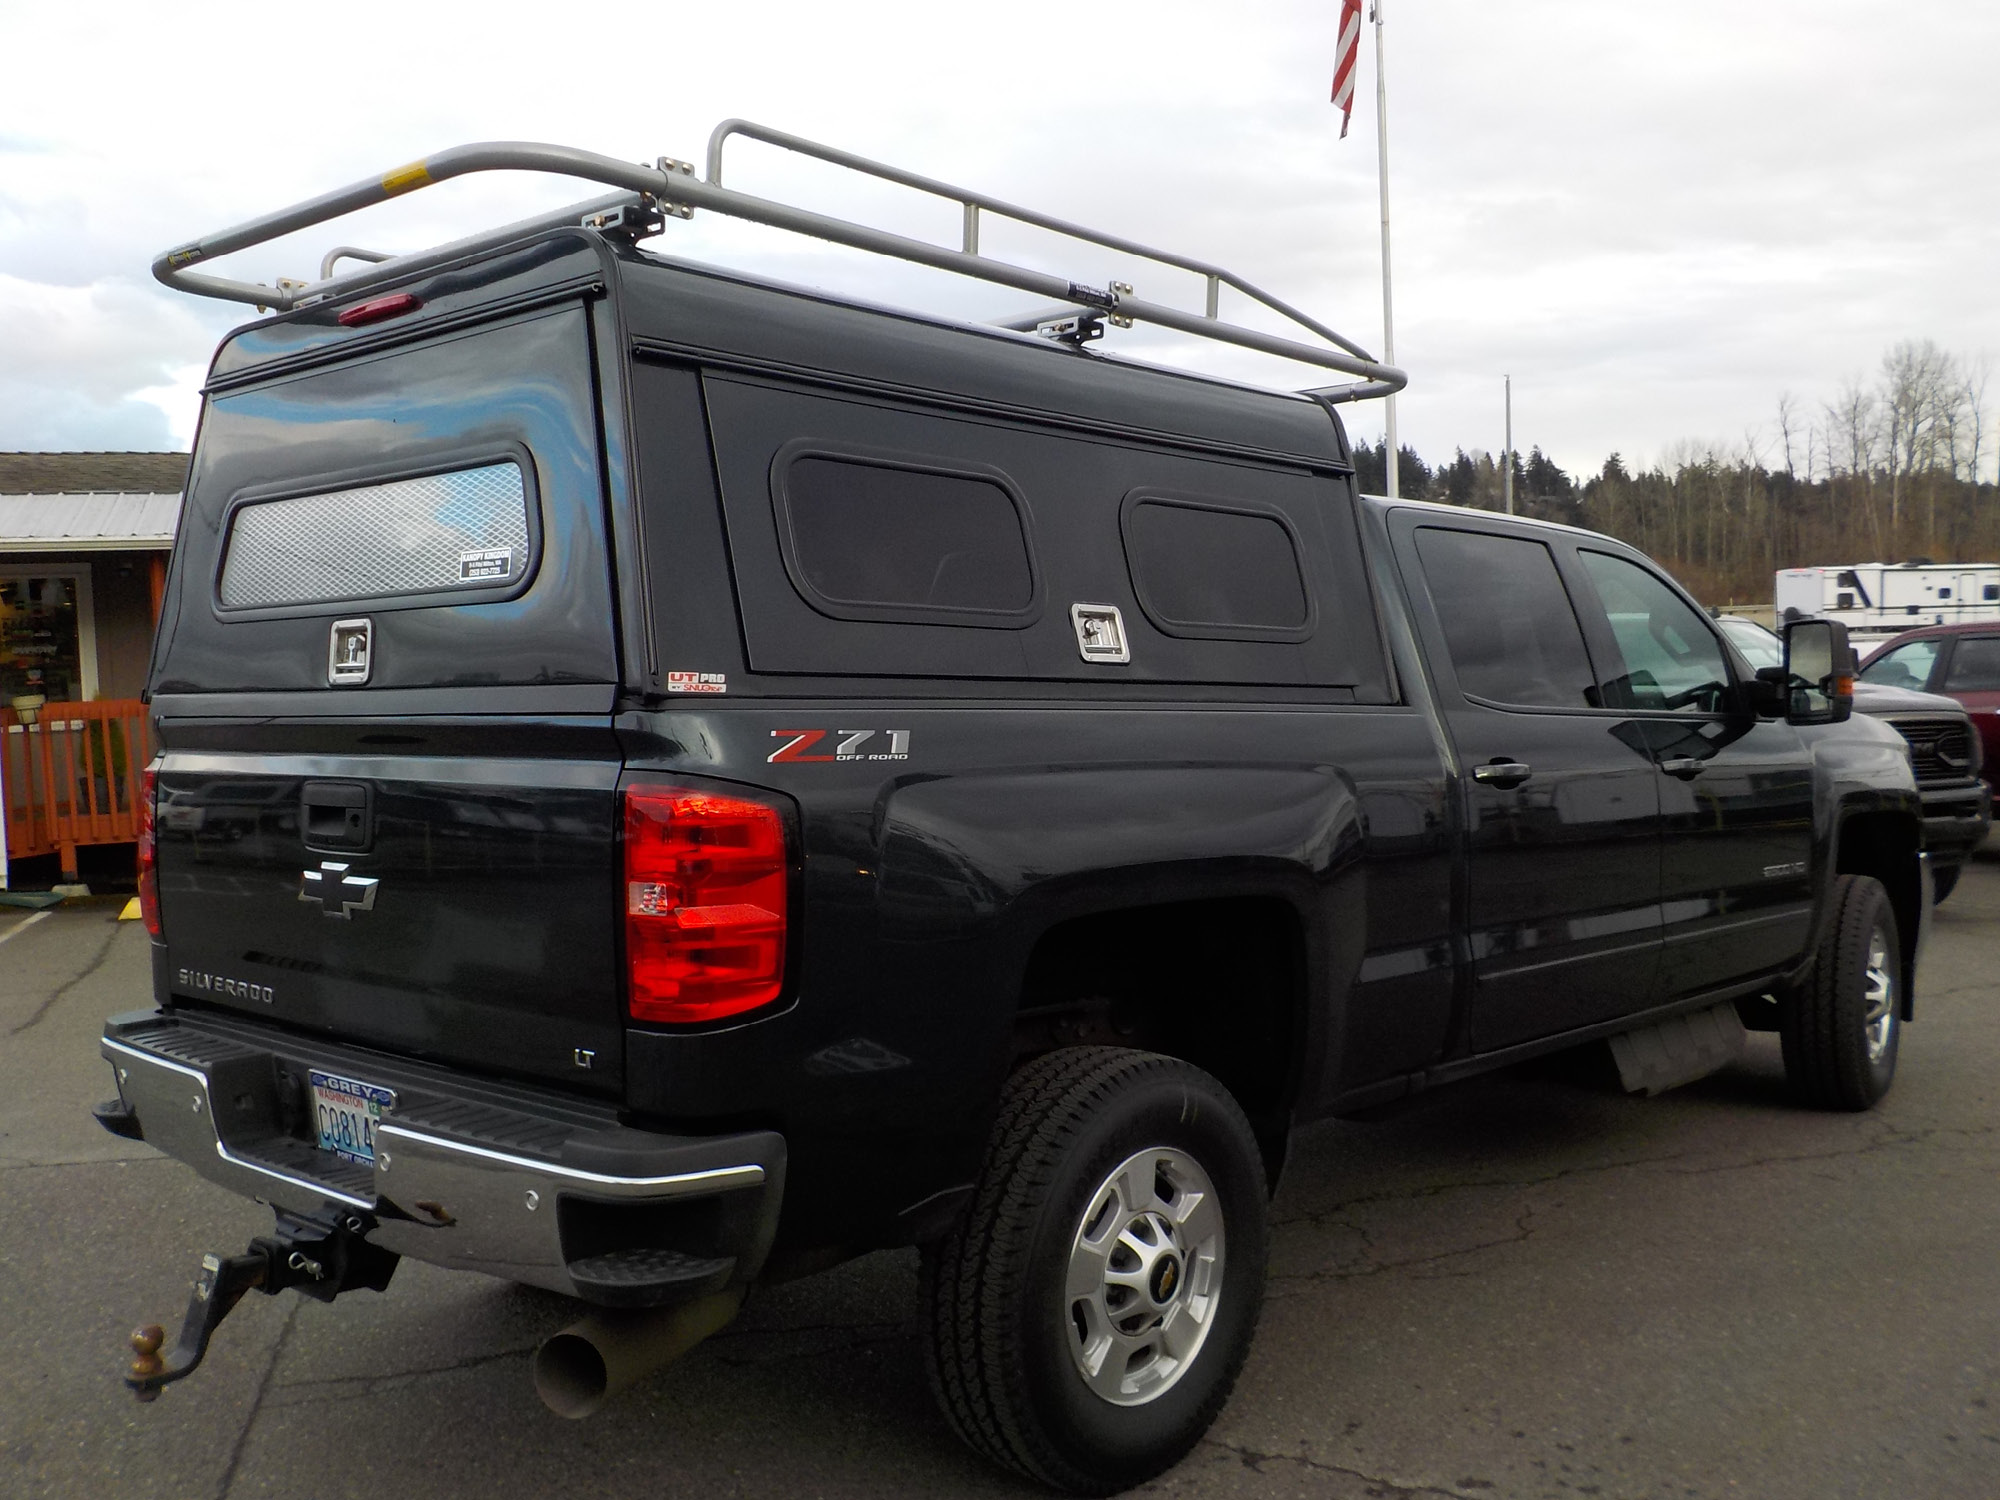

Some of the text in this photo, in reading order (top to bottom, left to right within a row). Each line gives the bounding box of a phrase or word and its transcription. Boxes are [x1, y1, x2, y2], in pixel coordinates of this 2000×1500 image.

[462, 551, 509, 561] KANOPY KINGDOM
[670, 673, 726, 683] UT PRO
[767, 730, 911, 763] Z71
[178, 968, 274, 1004] SILVERADO
[574, 1048, 596, 1069] LT
[327, 1077, 374, 1098] GREY
[317, 1088, 364, 1109] WASHINGTON
[369, 1102, 379, 1113] 12
[318, 1103, 379, 1156] C0814
